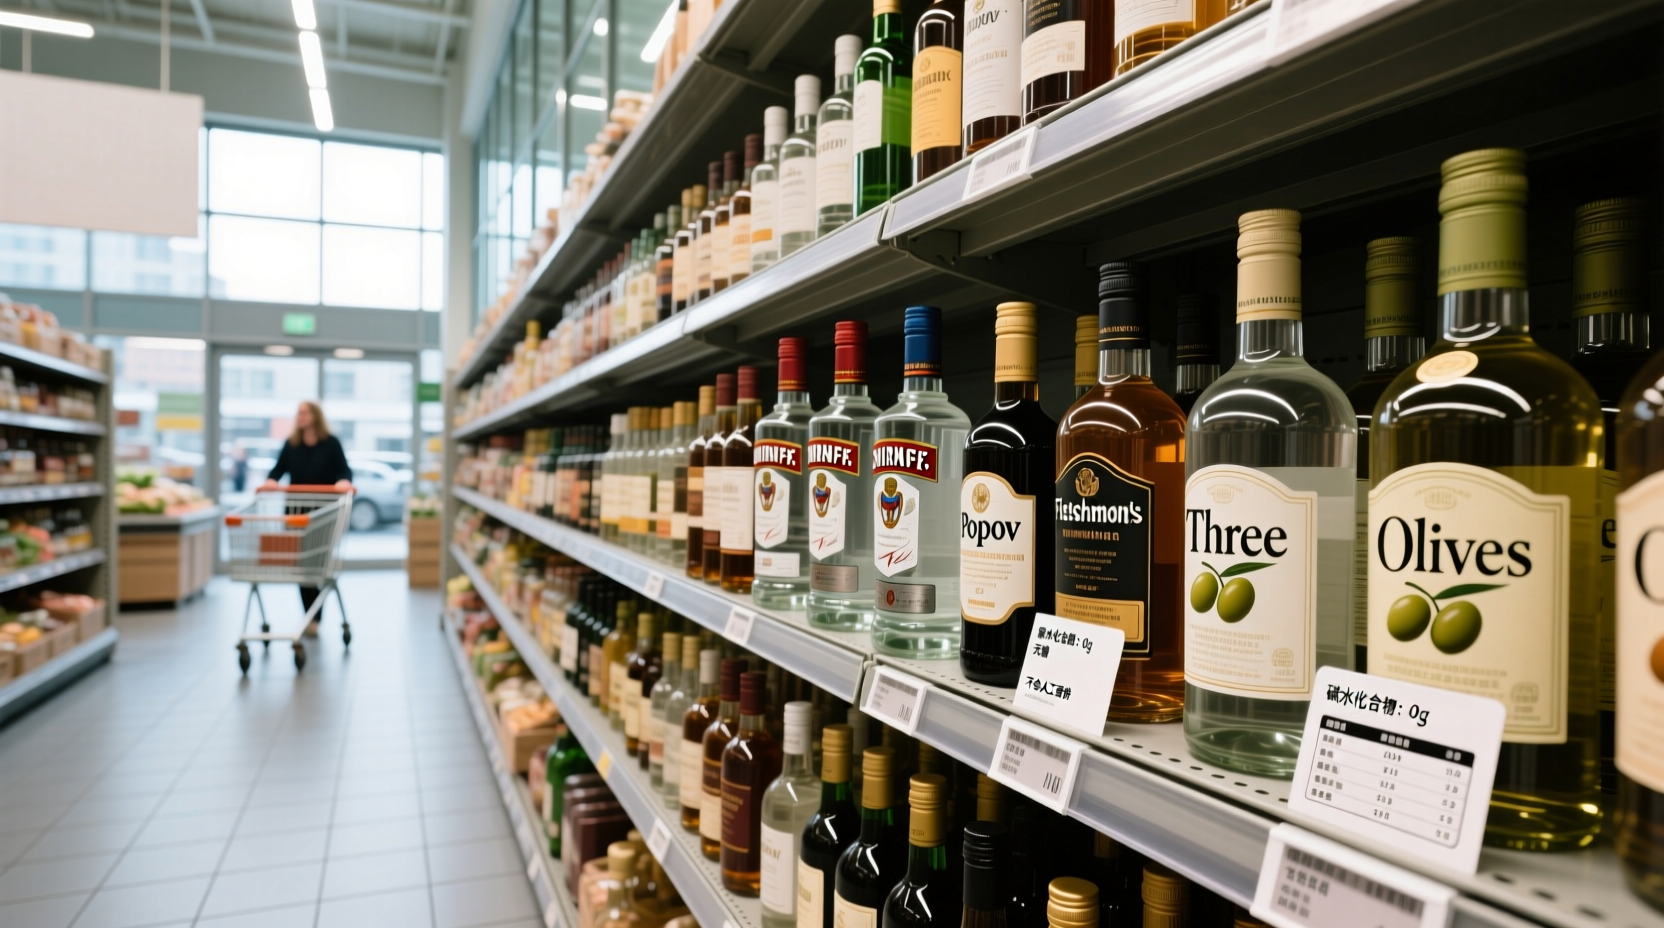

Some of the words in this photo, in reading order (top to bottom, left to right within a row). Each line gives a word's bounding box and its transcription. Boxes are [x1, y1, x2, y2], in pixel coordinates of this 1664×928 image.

[961, 512, 1021, 547] Popov
[1186, 508, 1288, 558] Three
[1377, 516, 1532, 577] Olives
